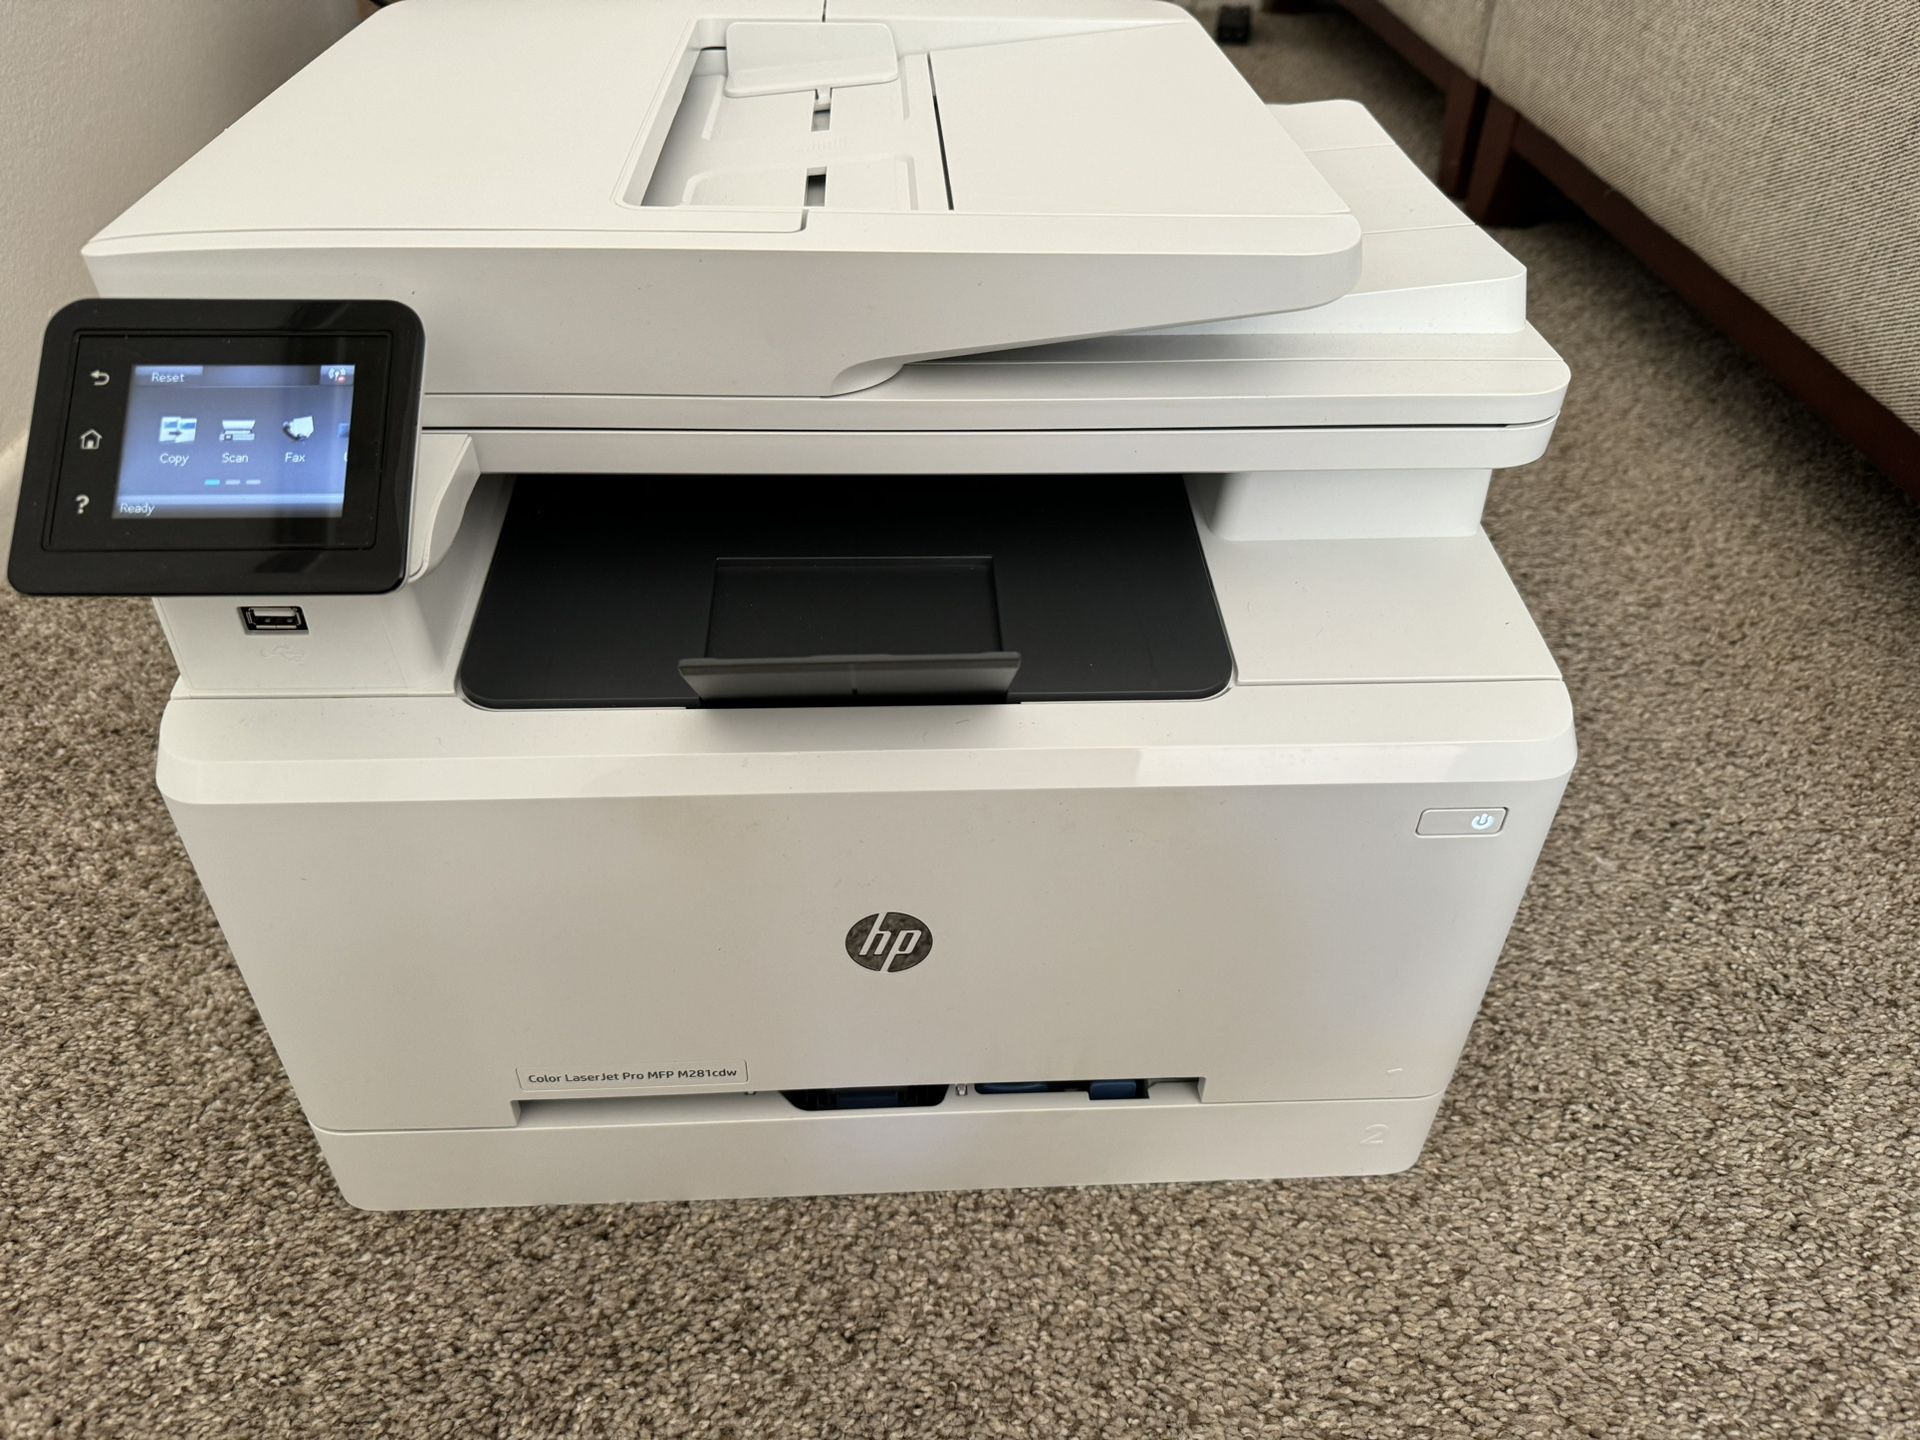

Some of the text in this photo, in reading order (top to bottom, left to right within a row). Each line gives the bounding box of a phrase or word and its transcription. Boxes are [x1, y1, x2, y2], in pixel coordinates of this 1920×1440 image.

[151, 372, 185, 383] Reset
[159, 452, 190, 467] Copy
[221, 452, 249, 464] Scan
[284, 452, 306, 463] Fax
[119, 503, 156, 516] Ready
[858, 911, 922, 973] hp
[527, 1067, 738, 1083] Color LaserJet Pro MFP M281cdw
